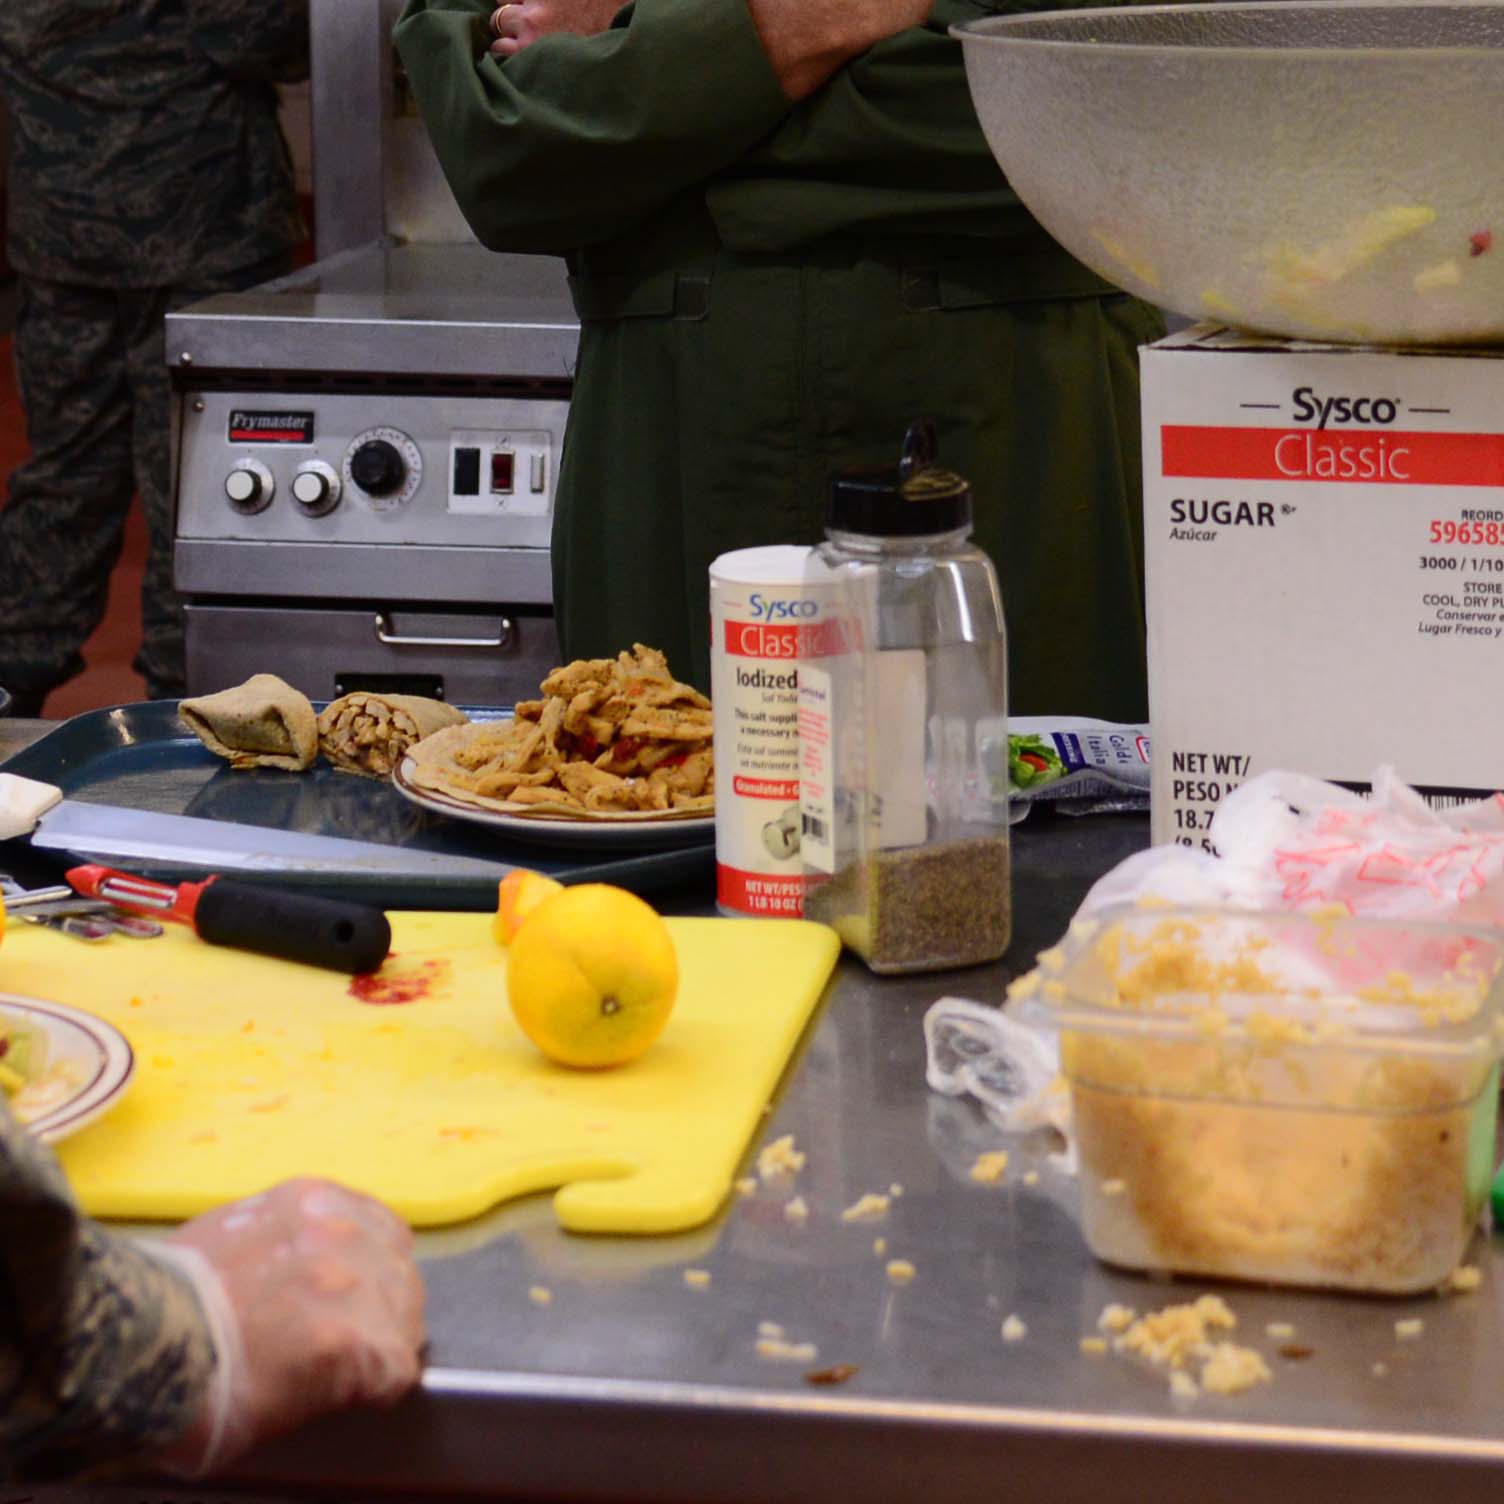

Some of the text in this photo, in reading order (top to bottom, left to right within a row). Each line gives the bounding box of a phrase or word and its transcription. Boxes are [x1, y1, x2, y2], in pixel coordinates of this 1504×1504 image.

[1292, 387, 1397, 431] Sysco
[232, 413, 309, 430] Frymaster
[1274, 433, 1410, 480] Classic
[1169, 499, 1276, 528] SUGAR
[1169, 527, 1218, 542] Azúcar
[1419, 556, 1458, 570] 3000
[1470, 558, 1504, 573] 1/10
[1463, 581, 1503, 595] STORE
[749, 593, 819, 623] Sysco
[1463, 595, 1489, 608] DRY
[1436, 608, 1496, 621] Conservar
[1418, 621, 1452, 637] Lugar
[1455, 623, 1493, 635] Fresco
[1494, 627, 1503, 638] y
[736, 666, 799, 689] Iodized
[1172, 751, 1251, 777] NET WT/
[1173, 779, 1221, 803] PESO
